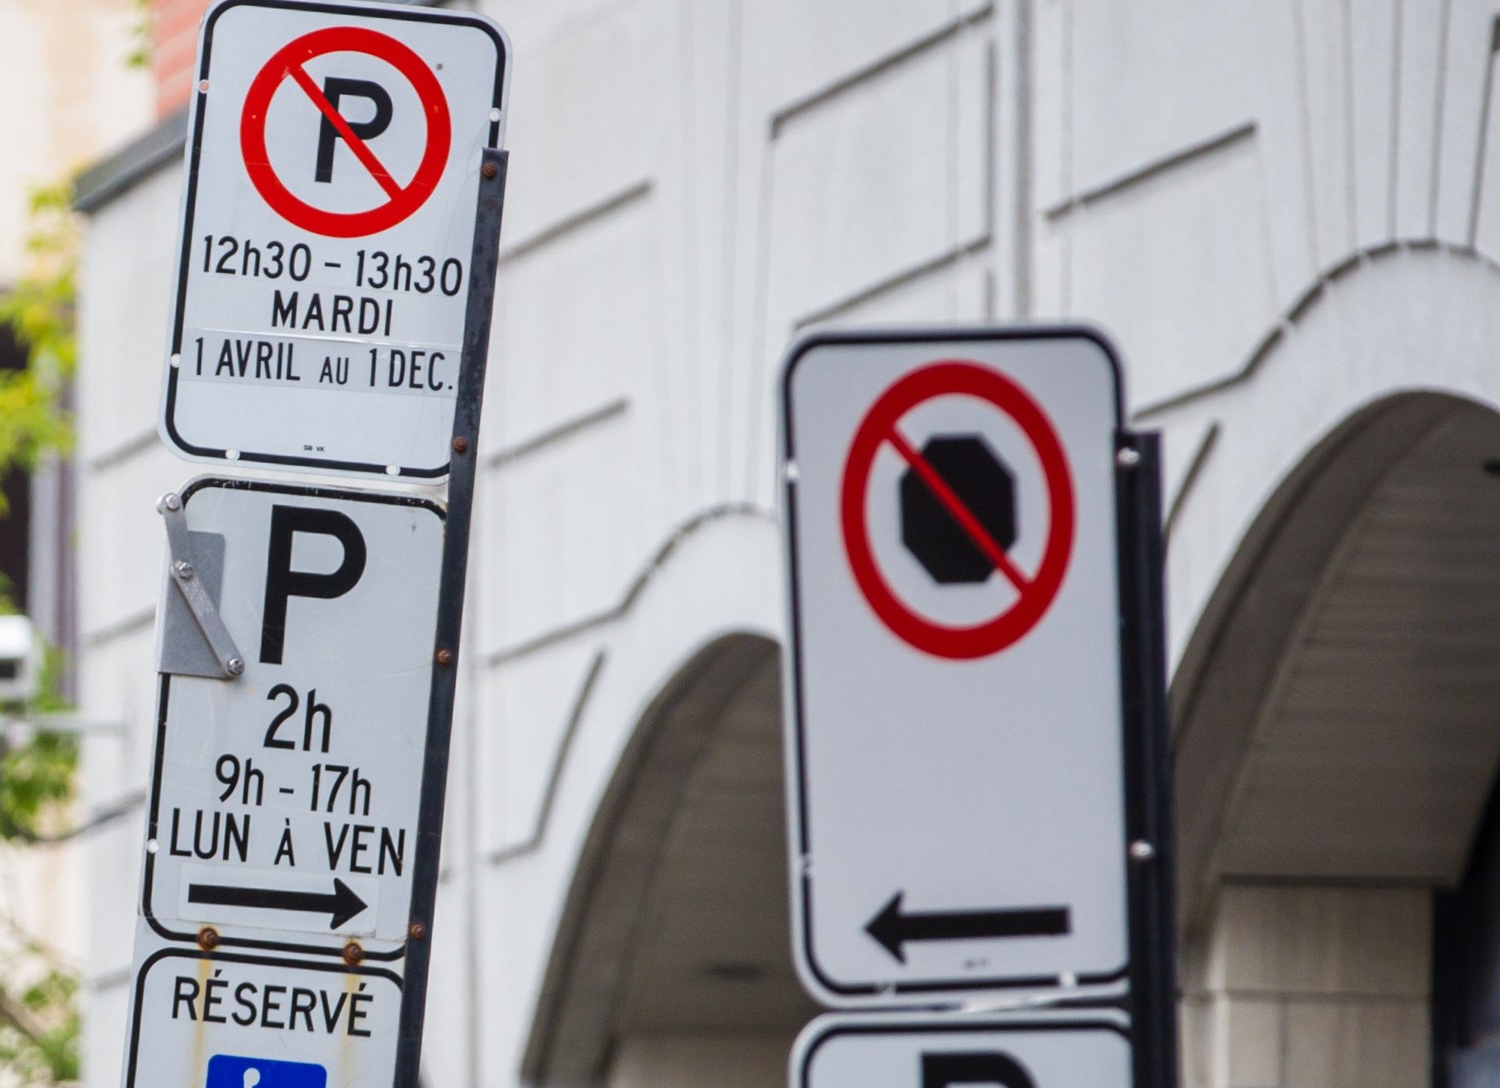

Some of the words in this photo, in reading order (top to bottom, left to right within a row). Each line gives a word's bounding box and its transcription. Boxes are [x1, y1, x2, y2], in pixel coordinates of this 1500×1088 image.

[315, 76, 393, 183] P
[202, 235, 312, 281] 12h30
[356, 249, 464, 296] 13h30
[271, 290, 392, 336] MARDI
[216, 340, 301, 381] AVRIL
[320, 356, 349, 386] AU
[389, 350, 454, 391] DEC.
[260, 504, 367, 664] P
[263, 683, 332, 753] 2h
[215, 753, 265, 806] 9h
[310, 763, 372, 816] 17h
[170, 808, 250, 862] LUN
[274, 818, 295, 867] À
[324, 821, 406, 877] VEN
[171, 969, 374, 1037] RÉSERVÉ
